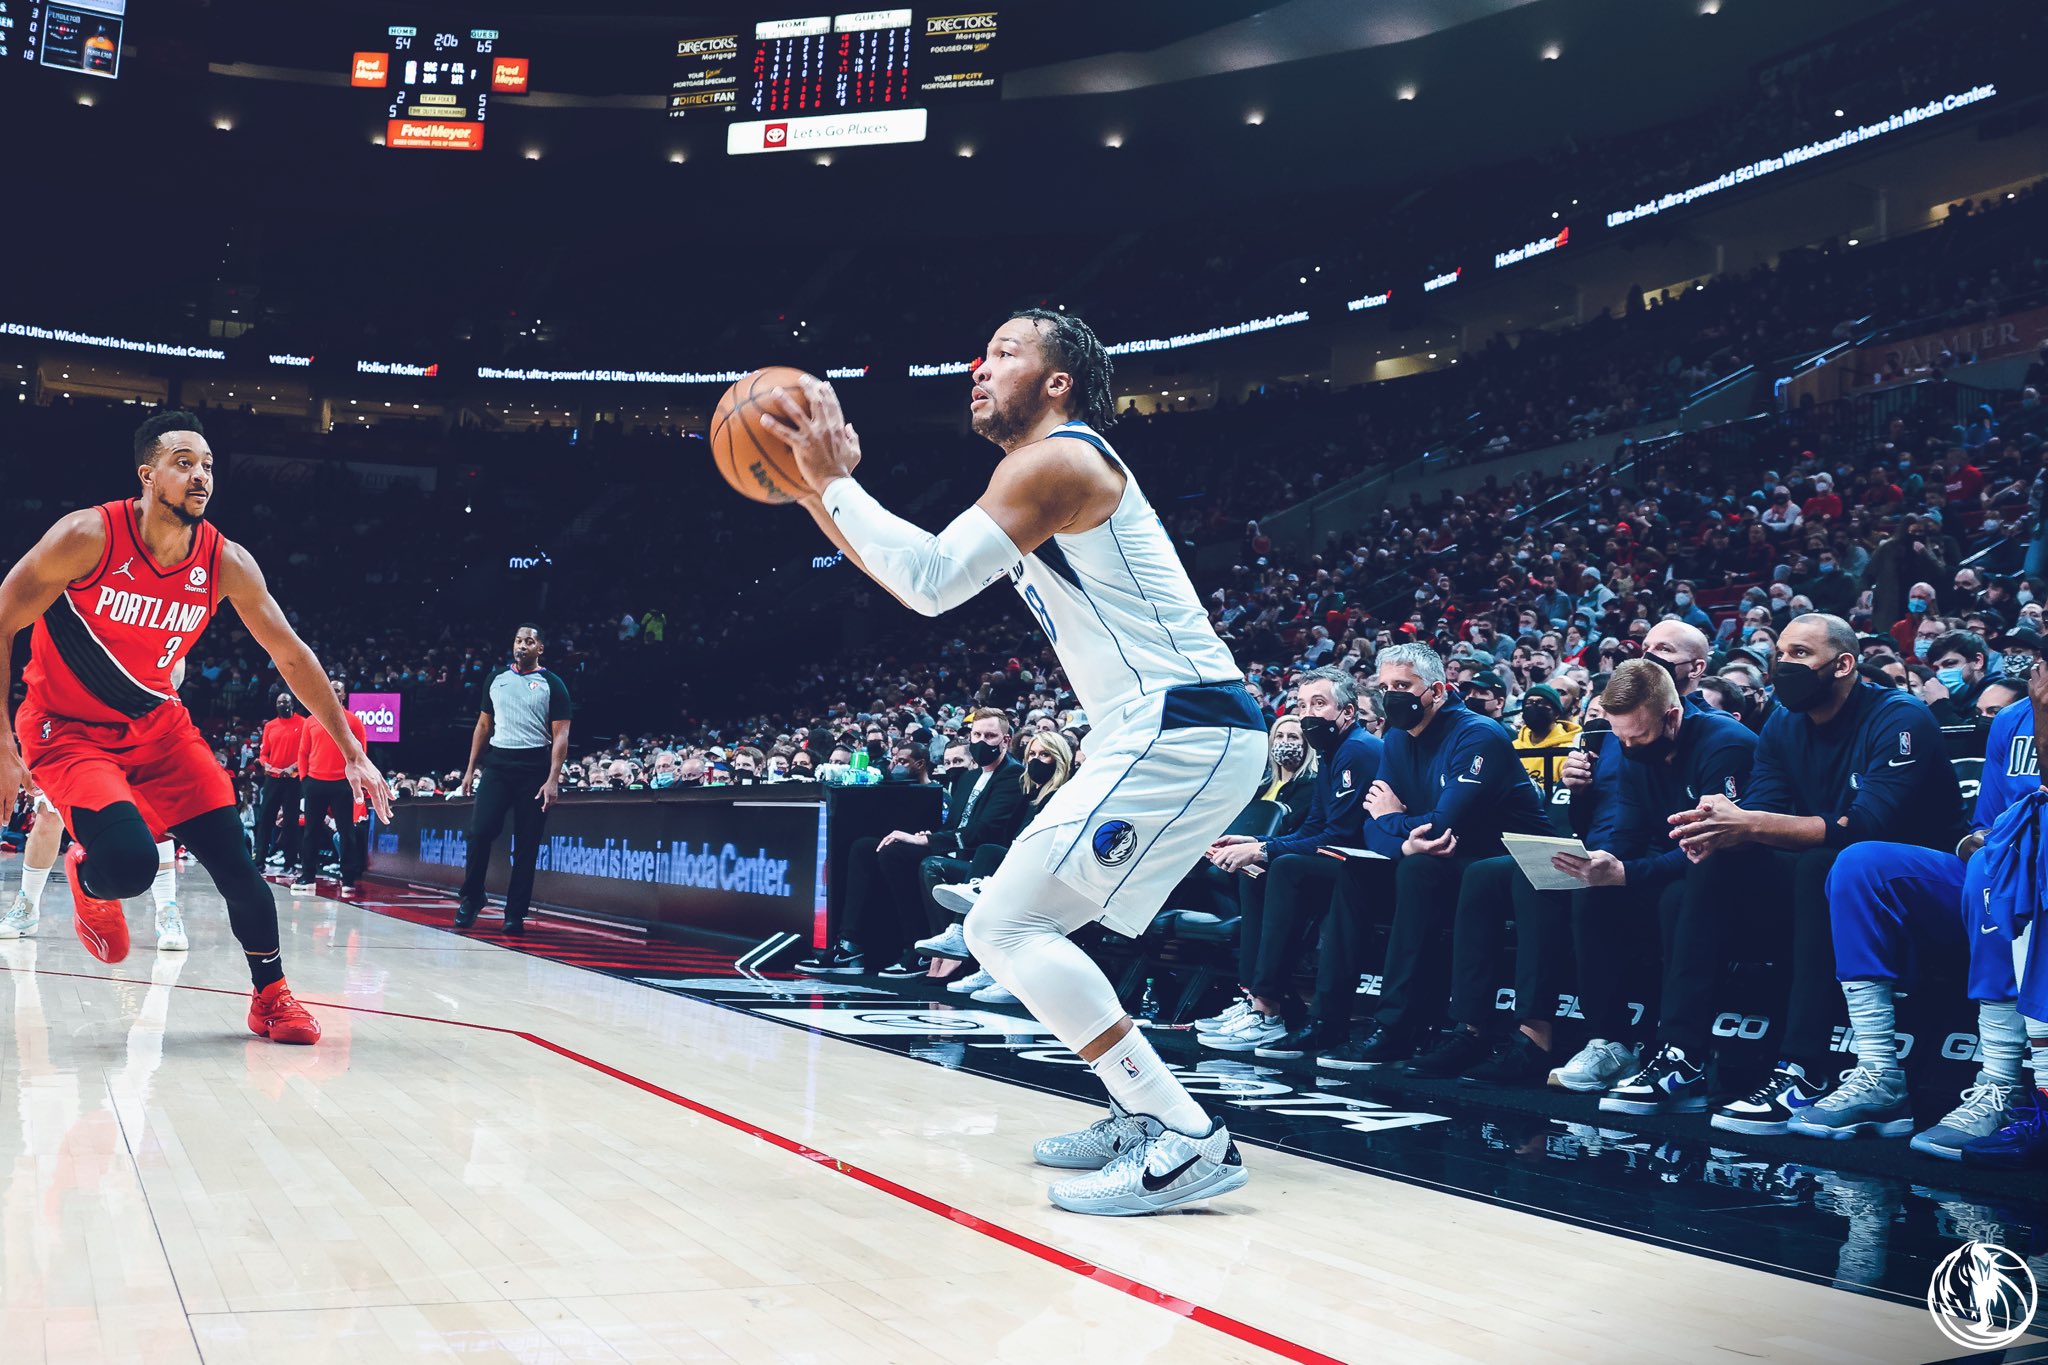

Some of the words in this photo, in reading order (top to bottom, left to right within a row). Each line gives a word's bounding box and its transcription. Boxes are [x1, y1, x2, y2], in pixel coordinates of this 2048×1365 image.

[390, 27, 414, 35] HOME
[777, 21, 808, 29] HOME
[395, 37, 411, 49] 54
[356, 60, 380, 70] Fred
[496, 65, 519, 75] Fred
[355, 69, 385, 80] Meyer
[495, 74, 525, 85] Meyer
[966, 72, 983, 80] CITY
[673, 80, 704, 88] MORTGAGE
[921, 81, 957, 90] MORTGAGE
[958, 79, 994, 87] SPECIALIST
[397, 91, 405, 104] 2
[673, 92, 735, 106] #DIRECTFAN
[825, 125, 844, 137] Go
[848, 122, 888, 135] Places
[1735, 165, 1755, 183] 5G
[1754, 156, 1784, 177] Ultra
[1783, 132, 1847, 166] Wideband
[1846, 130, 1859, 145] is
[1858, 120, 1890, 141] here
[1889, 114, 1903, 130] in
[1903, 100, 1943, 125] Moda
[1943, 84, 1996, 111] Center.
[1424, 271, 1458, 292] verizon
[1348, 294, 1387, 311] verizon
[1130, 340, 1145, 353] 5G
[1145, 338, 1169, 352] Ultra
[1170, 328, 1213, 349] Wideband
[1220, 325, 1241, 338] here
[1241, 322, 1250, 334] in
[1250, 317, 1275, 332] Moda
[8, 324, 25, 336] 5G
[26, 326, 53, 340] Ultra
[54, 330, 110, 347] Wideband
[110, 336, 119, 348] is
[120, 338, 145, 352] here
[146, 342, 156, 353] in
[157, 343, 187, 357] Moda
[188, 347, 225, 360] Center.
[269, 354, 310, 366] verizon
[357, 361, 390, 375] Holier
[390, 362, 425, 377] Molier
[478, 368, 526, 381] Ultra-fast,
[526, 369, 595, 382] ultra-powerful
[595, 370, 610, 382] 5G
[611, 371, 636, 382] Ultra
[636, 371, 686, 383] Wideband
[686, 372, 694, 383] is
[694, 372, 716, 383] here
[717, 371, 726, 382] in
[826, 367, 865, 379] verizon
[909, 365, 940, 377] Holier
[940, 362, 971, 376] Molier
[94, 585, 207, 633] PORTLAND
[157, 636, 183, 669] 3
[551, 835, 609, 878] Wideband
[609, 838, 620, 879] is
[622, 839, 655, 883] here
[655, 841, 670, 883] in
[671, 841, 717, 890] Moda
[719, 843, 790, 896] Center.
